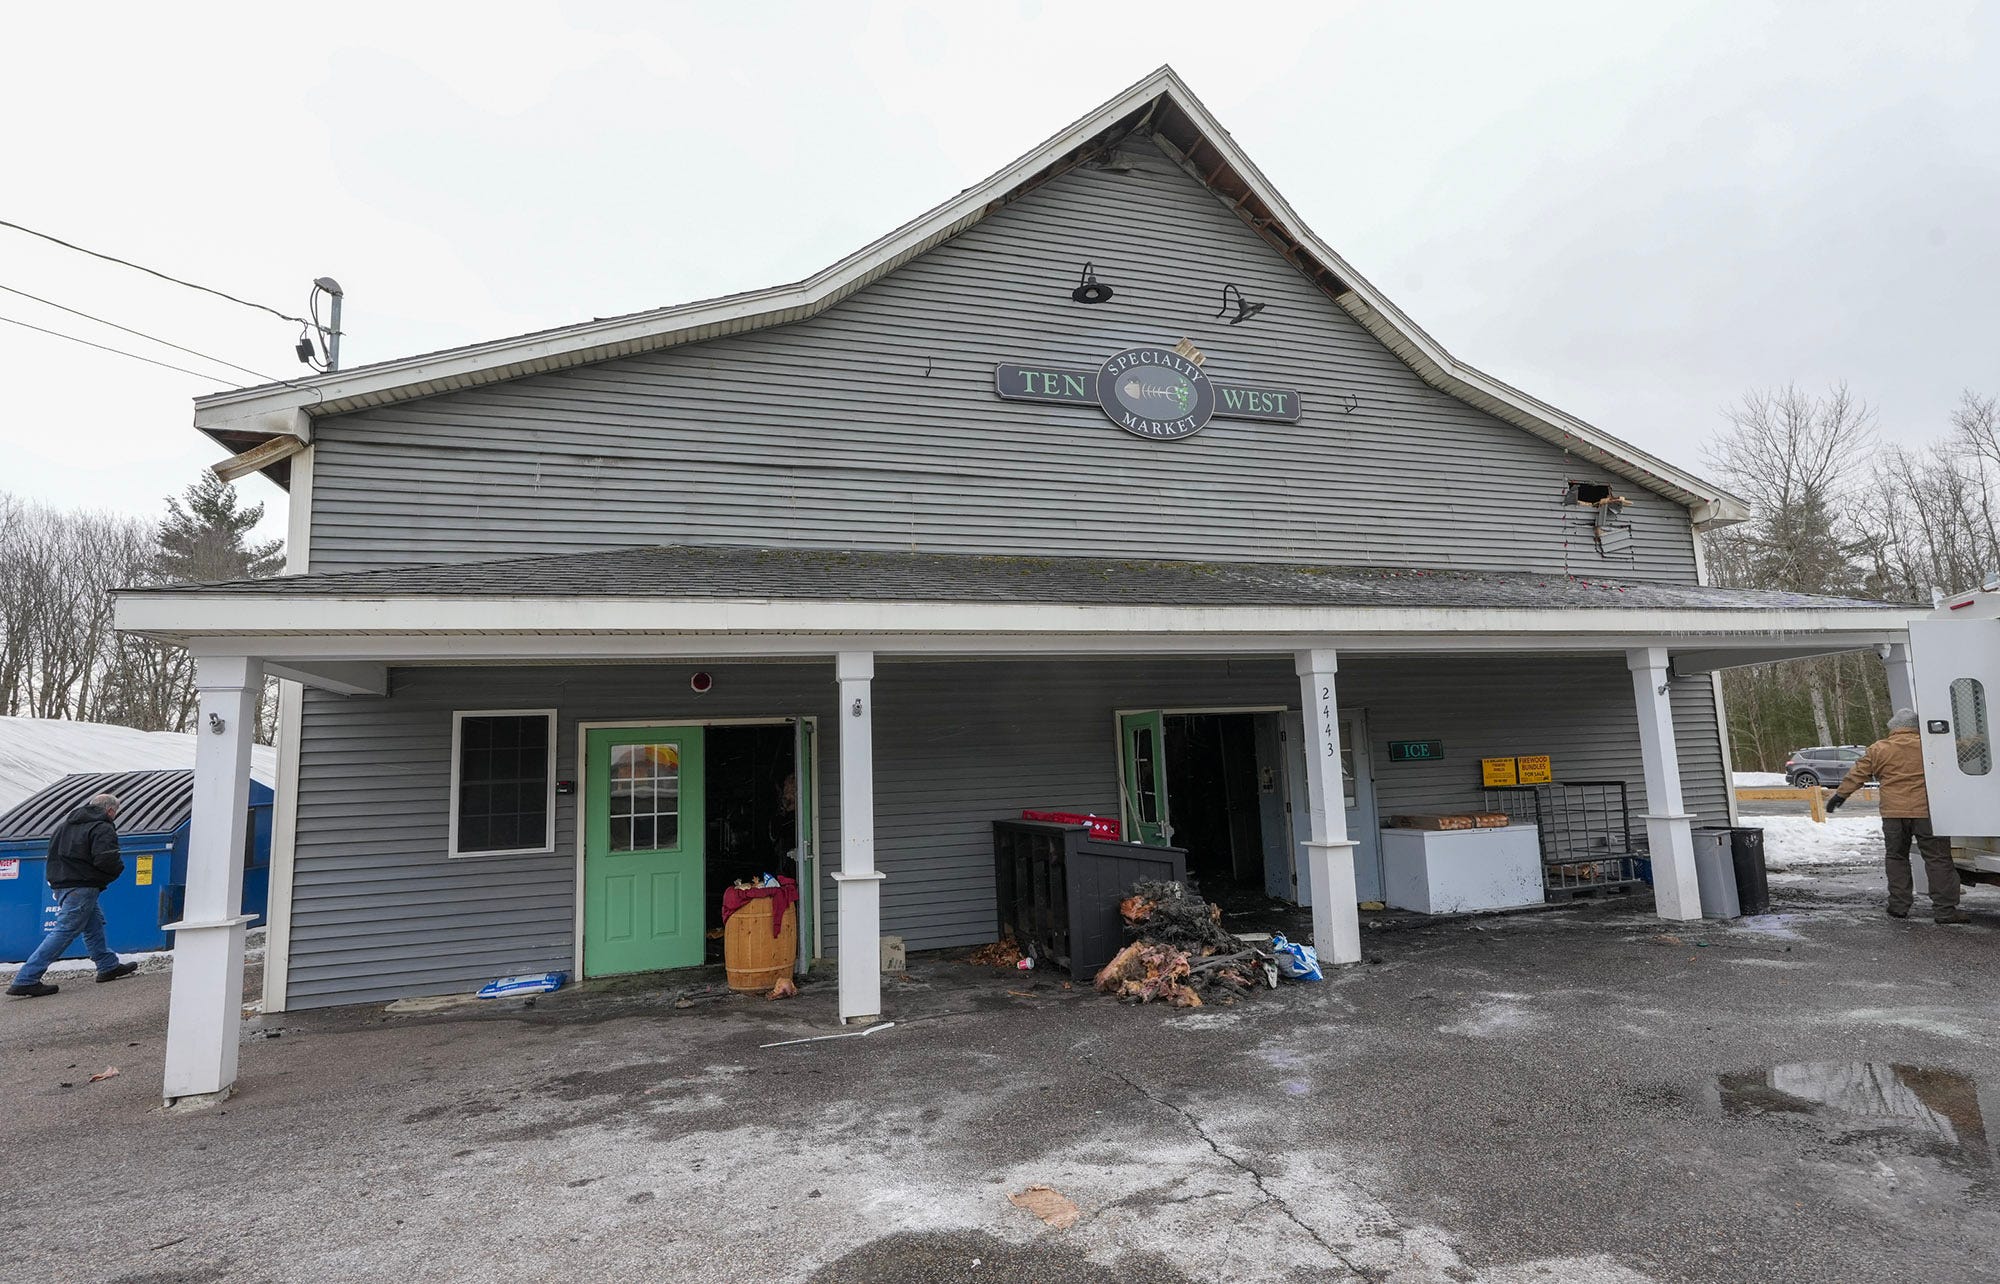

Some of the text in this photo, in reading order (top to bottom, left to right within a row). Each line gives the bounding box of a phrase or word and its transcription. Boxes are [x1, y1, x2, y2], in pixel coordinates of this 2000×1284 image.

[1107, 351, 1203, 383] SPECIALTY
[1018, 370, 1288, 414] TEN WEST
[1122, 412, 1197, 435] MARKET
[1322, 687, 1334, 757] 2443
[1403, 744, 1430, 758] ICE
[1519, 756, 1548, 764] FIREWOOD
[1521, 763, 1547, 771] BUNDLES
